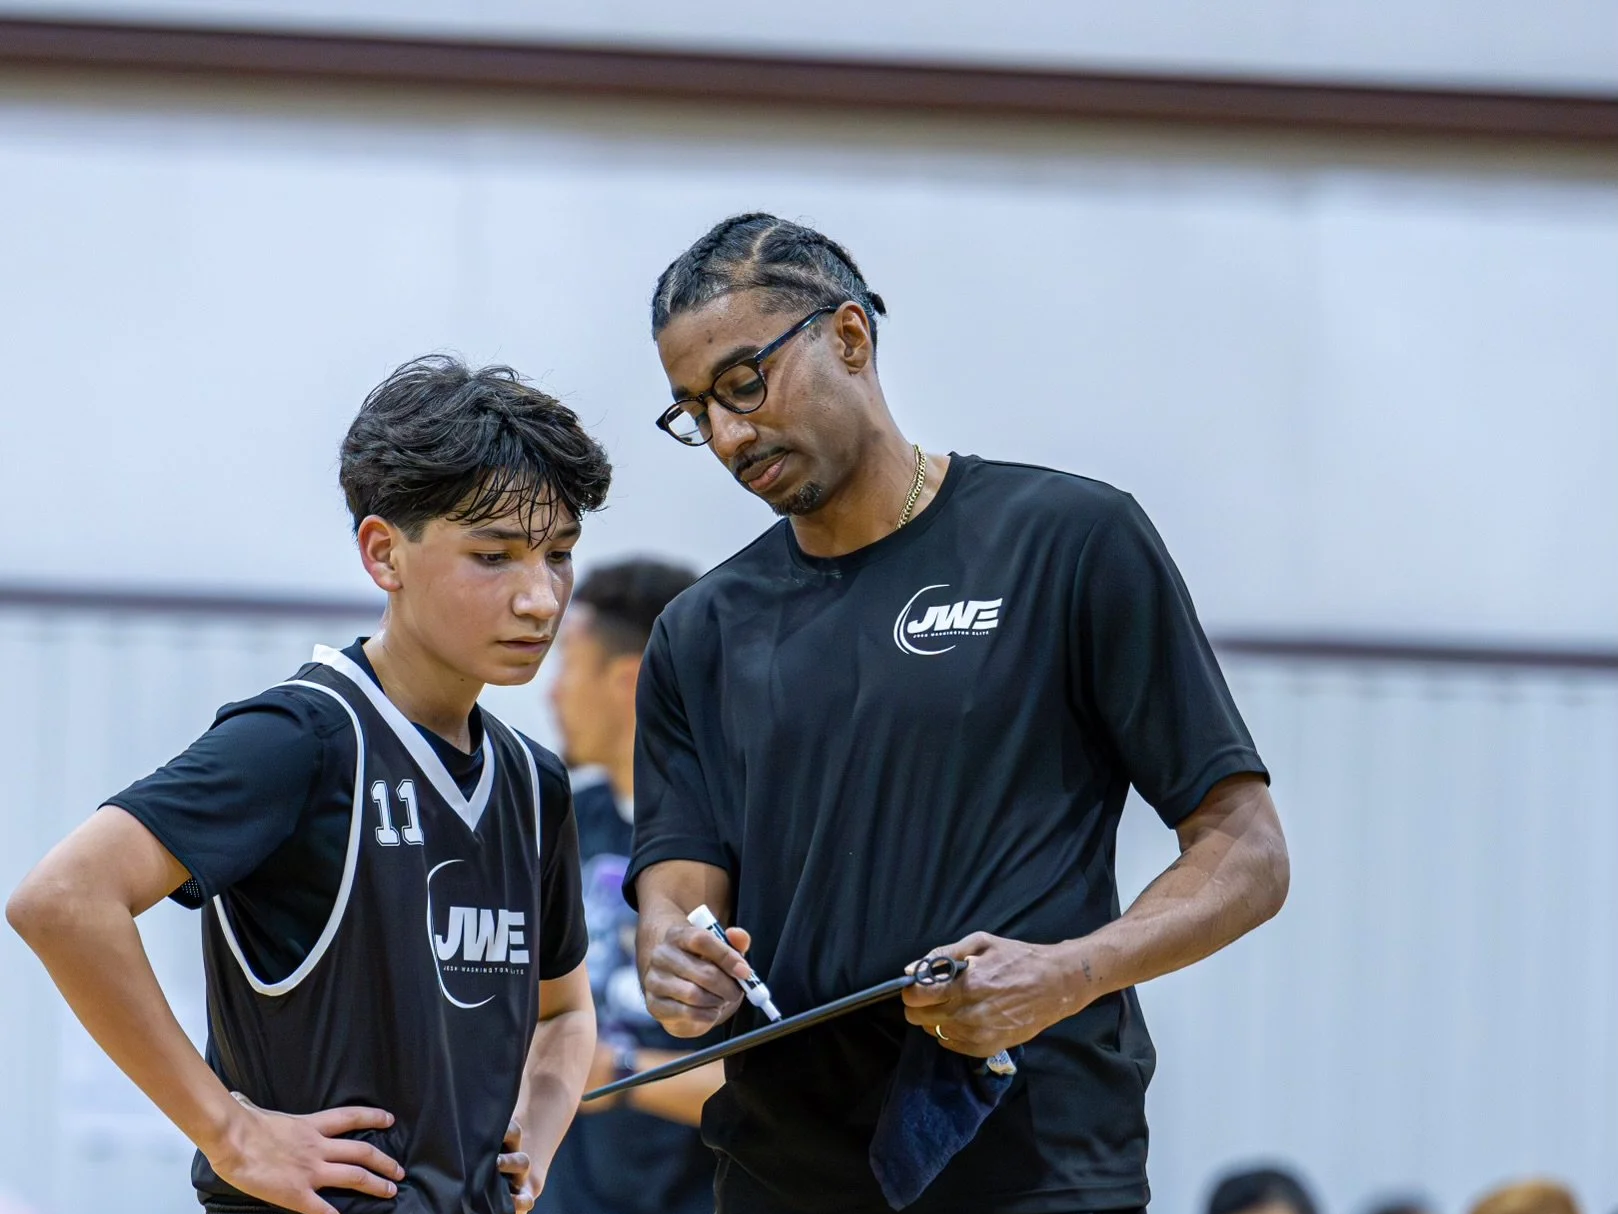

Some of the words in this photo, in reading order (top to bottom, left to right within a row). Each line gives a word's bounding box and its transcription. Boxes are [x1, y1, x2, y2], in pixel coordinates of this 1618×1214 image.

[906, 597, 1003, 634] JWE
[371, 779, 425, 847] 11
[434, 906, 530, 964] JWE
